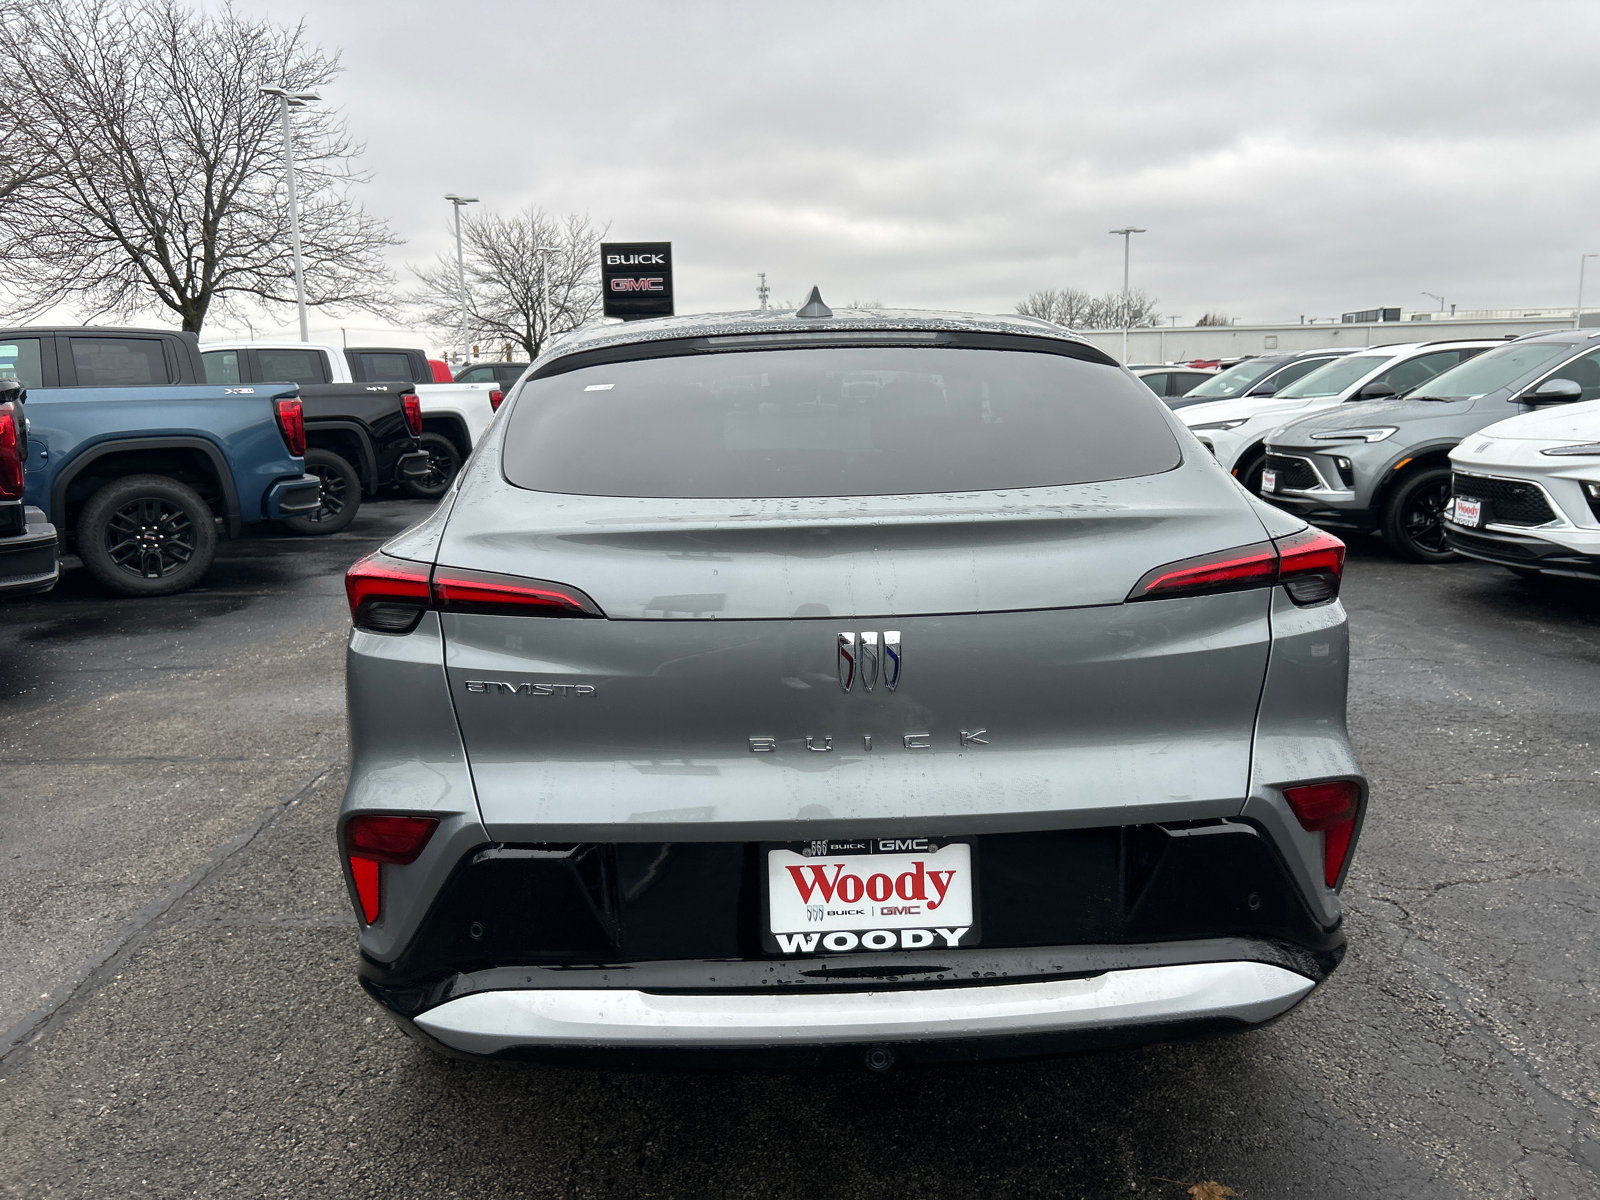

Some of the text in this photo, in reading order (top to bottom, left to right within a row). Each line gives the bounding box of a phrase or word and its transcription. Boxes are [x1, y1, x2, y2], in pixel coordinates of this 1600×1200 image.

[606, 254, 665, 265] BUICK
[611, 277, 664, 291] GMC
[465, 680, 597, 698] ENVISTA
[749, 729, 990, 752] BUICK
[879, 838, 929, 851] GMC
[785, 861, 957, 911] Woody
[880, 905, 921, 916] GMC
[775, 927, 970, 954] WOODY
